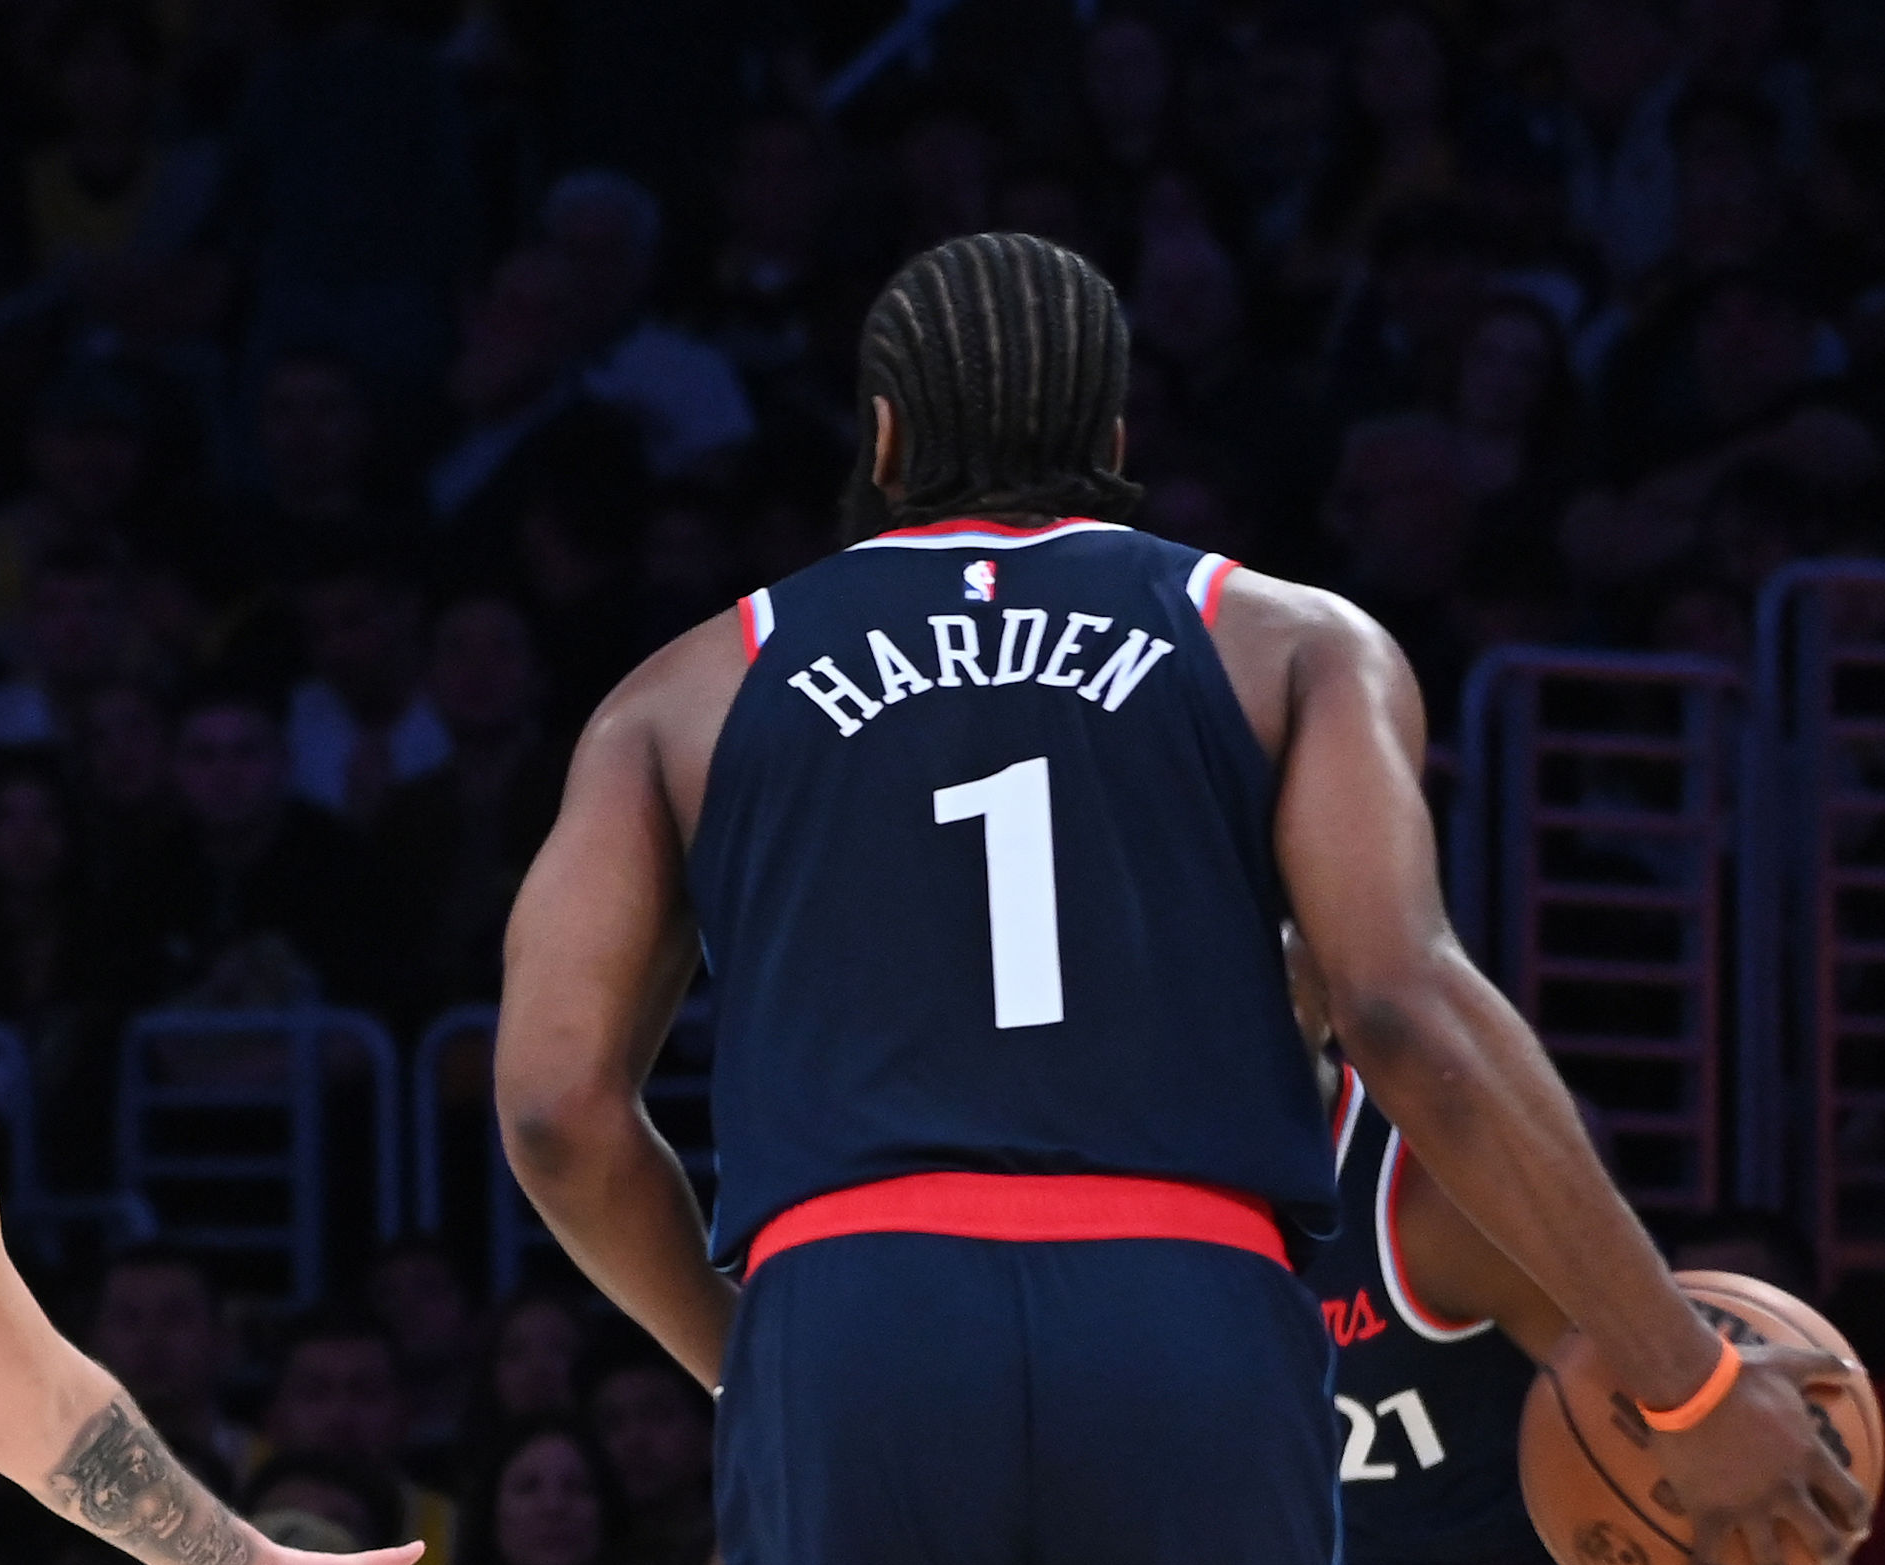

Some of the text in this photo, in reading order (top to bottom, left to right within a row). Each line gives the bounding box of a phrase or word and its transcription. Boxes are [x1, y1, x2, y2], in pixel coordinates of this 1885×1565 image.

[787, 608, 1175, 737] HARDEN
[933, 756, 1064, 1029] 1
[1333, 1387, 1446, 1482] 21
